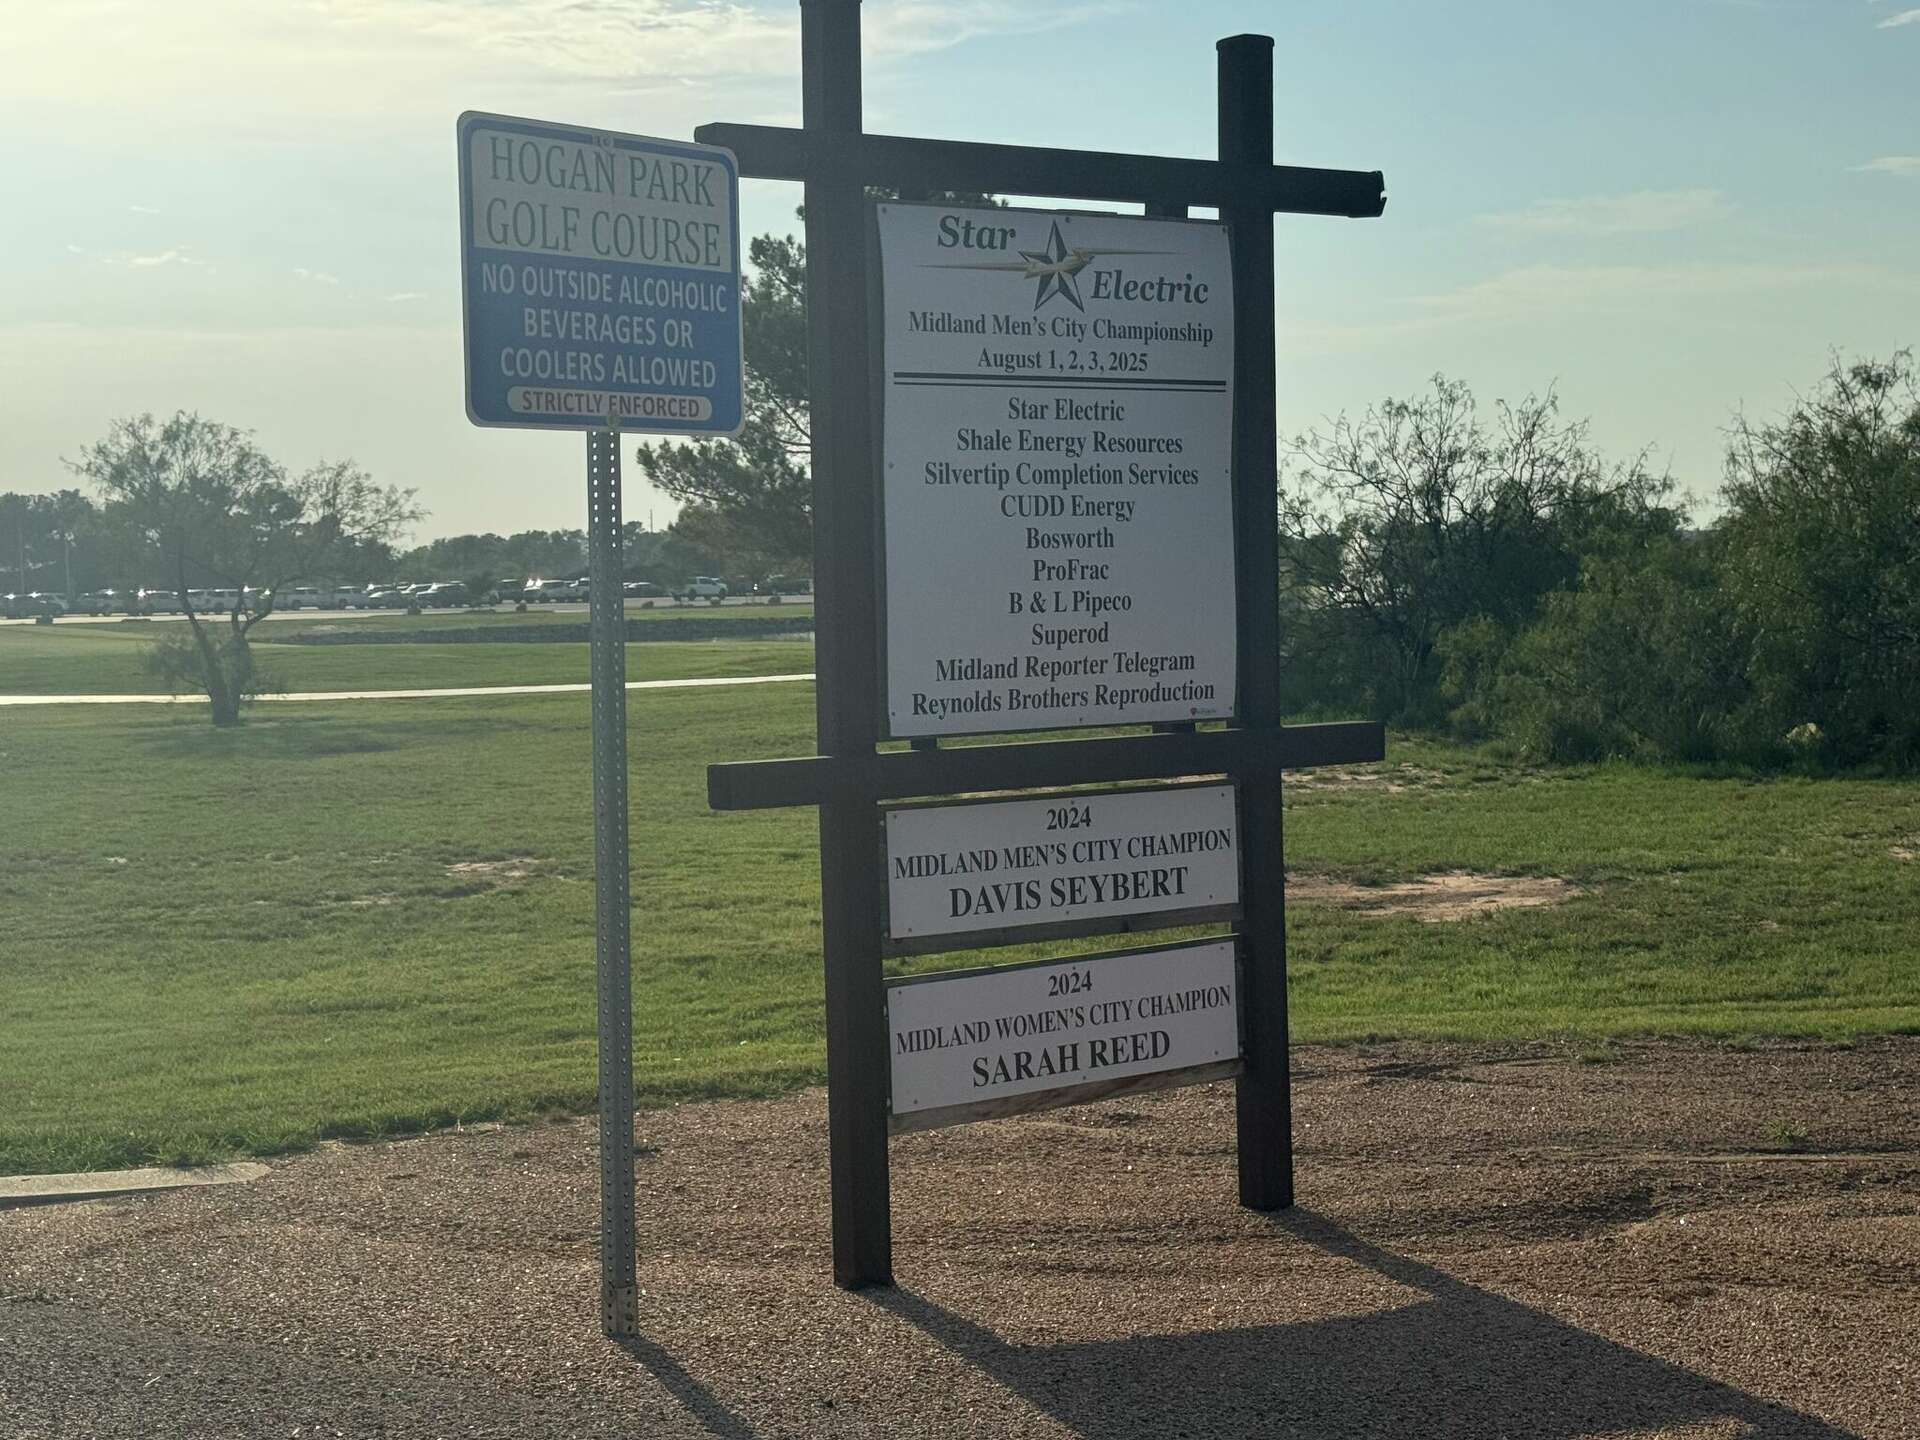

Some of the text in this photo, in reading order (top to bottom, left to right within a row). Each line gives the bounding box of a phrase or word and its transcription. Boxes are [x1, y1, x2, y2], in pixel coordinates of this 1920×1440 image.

[490, 137, 714, 207] HOGAN PARK
[486, 198, 721, 267] GOLF COURSE
[938, 216, 1016, 250] Star
[482, 263, 727, 312] NO OUTSIDE ALCOHOLIC
[1090, 271, 1208, 303] Electric
[524, 308, 693, 348] BEVERAGES OR
[909, 312, 1213, 347] Midland Men's City Championship
[501, 348, 716, 388] COOLERS ALLOWED
[978, 348, 1041, 372] August
[1109, 352, 1148, 372] 2025
[522, 390, 699, 417] STRICTLY ENFORCED
[1008, 398, 1124, 421] Star Electric
[957, 428, 1182, 457] Shale Energy Resources
[925, 461, 1198, 490] Silvertip Completion Services
[1001, 495, 1135, 521] CUDD Energy
[1026, 527, 1114, 549] Bosworth
[1033, 559, 1109, 581] ProFrac
[1008, 590, 1132, 617] B & L Pipeco
[1032, 622, 1108, 649] Superod
[936, 652, 1195, 681] Midland Reporter Telegram
[912, 680, 1214, 720] Reynolds Brothers Reproduction
[1046, 806, 1091, 830] 2024
[895, 828, 1231, 879] MIDLAND MEN'S CITY CHAMPION
[950, 866, 1188, 917] DAVIS SEYBERT
[1048, 970, 1092, 997] 2024
[897, 985, 1231, 1055] MIDLAND WOMEN'S CITY CHAMPION
[973, 1030, 1170, 1088] SARAH REED
